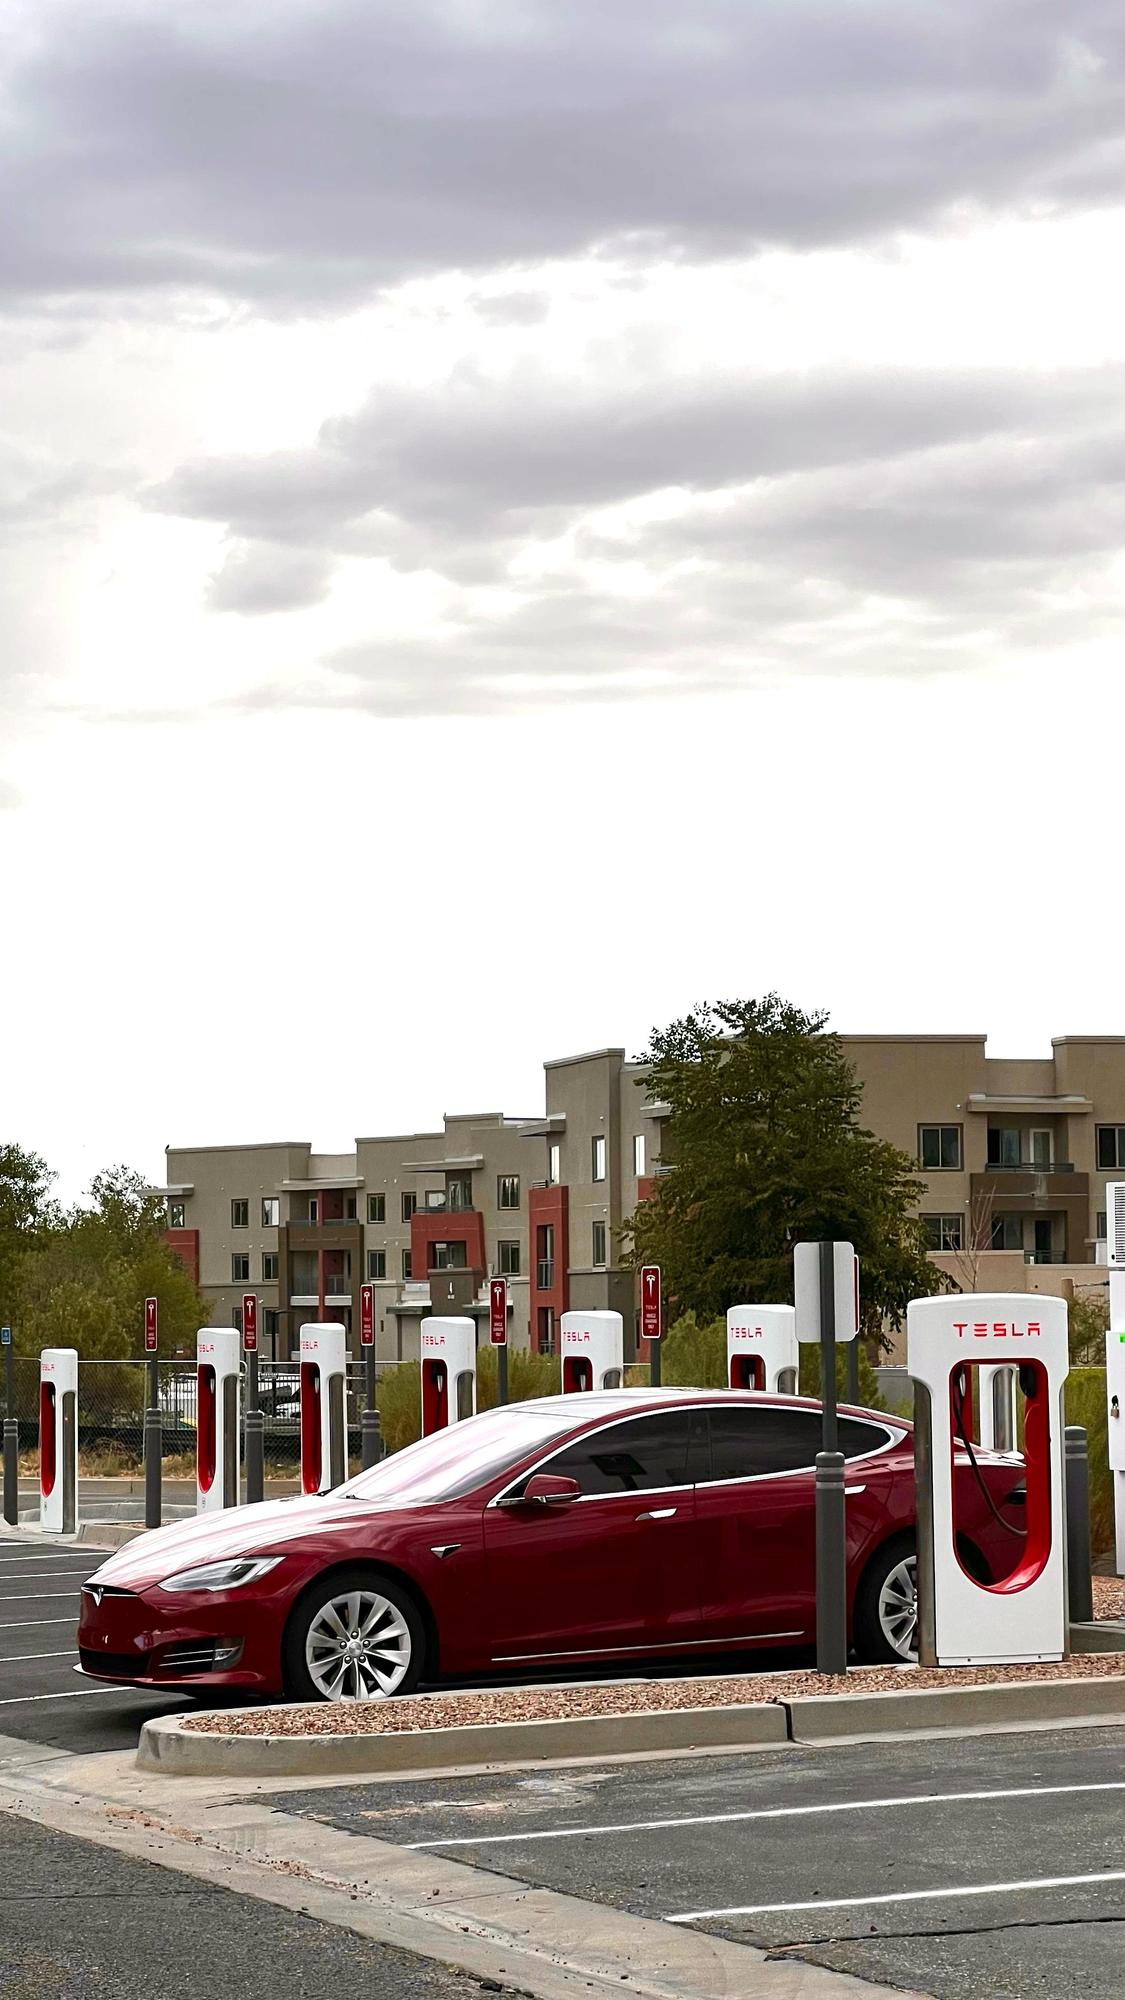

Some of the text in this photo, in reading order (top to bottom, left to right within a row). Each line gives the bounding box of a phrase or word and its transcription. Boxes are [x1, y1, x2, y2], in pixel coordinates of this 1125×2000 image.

[731, 1327, 762, 1338] TESLA
[953, 1322, 1041, 1338] TESLA
[563, 1331, 590, 1342] TESLA
